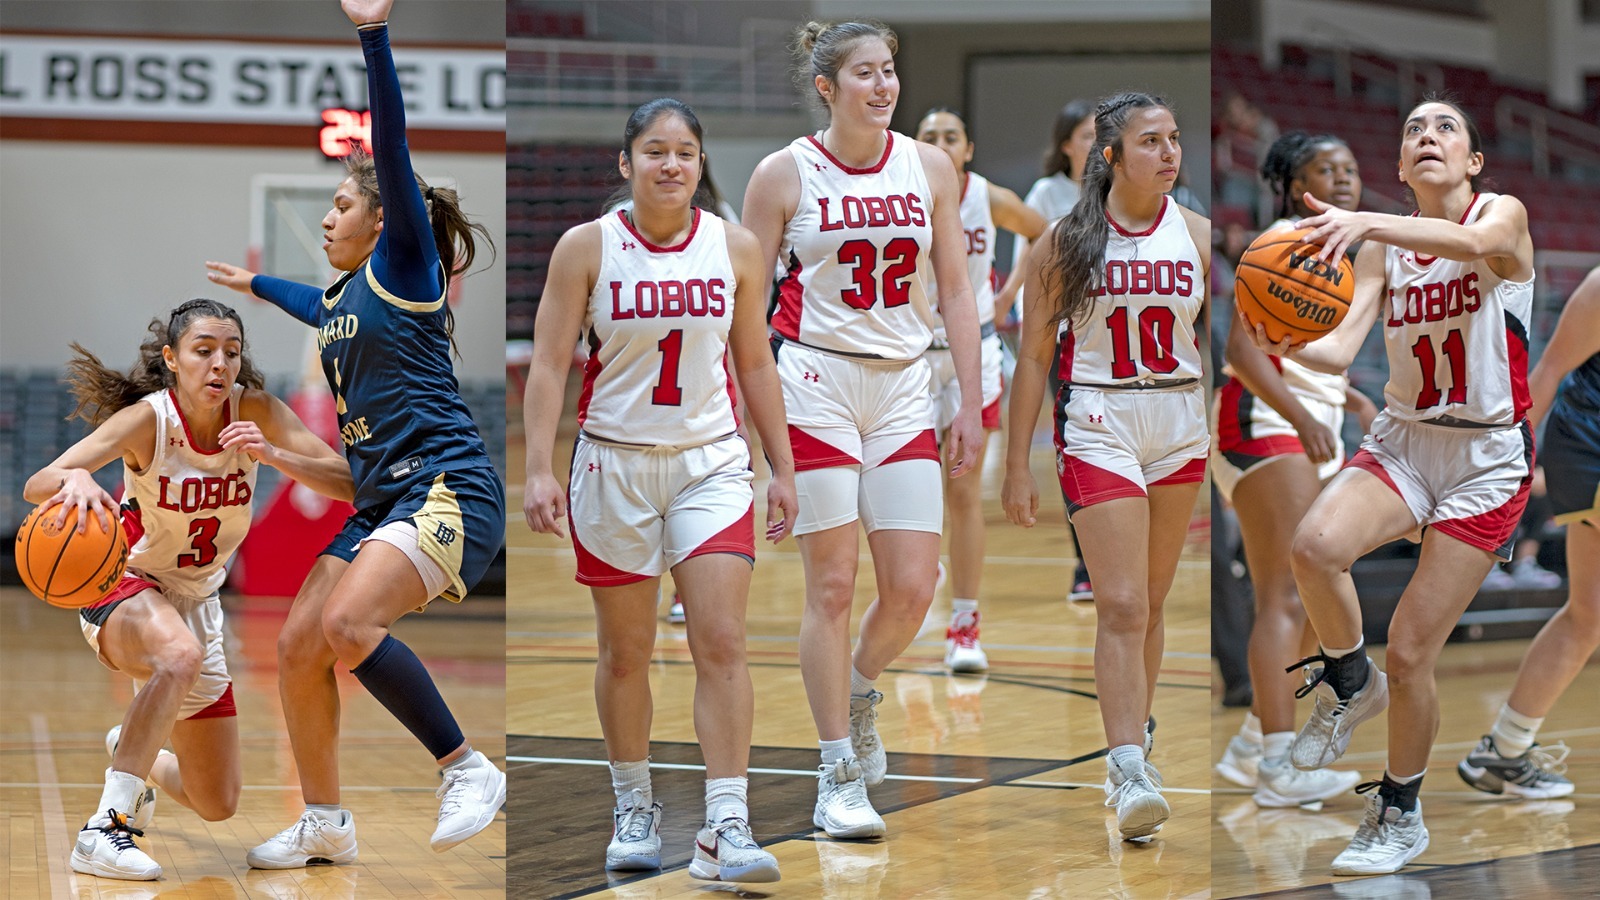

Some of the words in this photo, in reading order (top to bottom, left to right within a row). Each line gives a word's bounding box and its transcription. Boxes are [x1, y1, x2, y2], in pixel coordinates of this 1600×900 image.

[46, 53, 212, 103] ROSS
[320, 108, 373, 157] 24
[817, 192, 926, 232] LOBOS
[837, 237, 920, 310] 32
[1288, 252, 1344, 287] NCAA
[610, 278, 726, 321] LOBOS
[1267, 280, 1338, 325] Wilson
[1387, 271, 1482, 328] LOBOS
[1105, 305, 1180, 379] 10
[651, 329, 683, 407] 1
[1411, 328, 1469, 411] 11
[411, 460, 420, 469] M
[157, 468, 252, 513] LOBOS
[177, 515, 222, 568] 3
